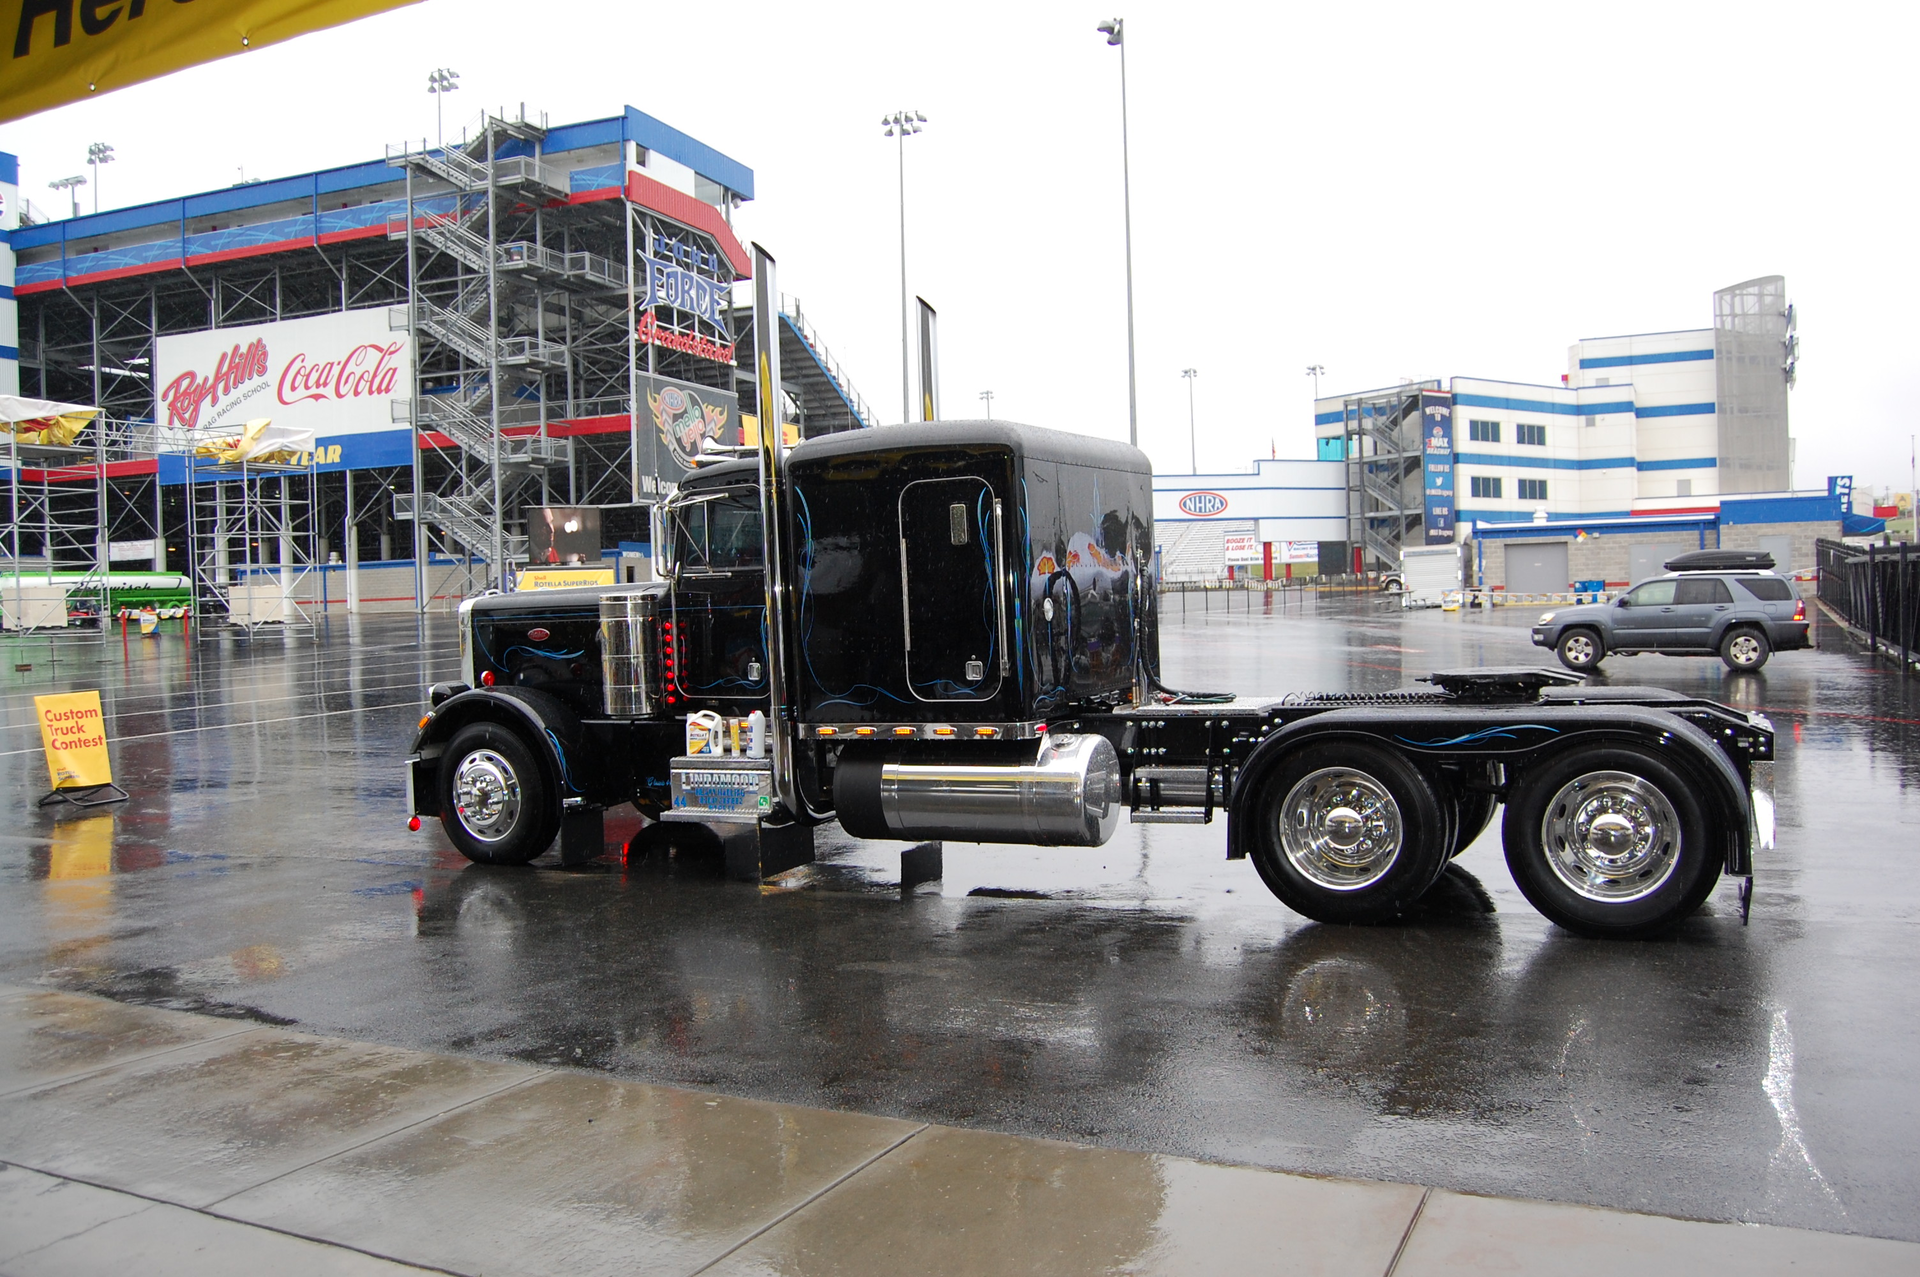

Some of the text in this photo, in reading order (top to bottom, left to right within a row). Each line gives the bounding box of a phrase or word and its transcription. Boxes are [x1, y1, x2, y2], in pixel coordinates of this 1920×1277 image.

[637, 249, 732, 341] FORCE
[637, 311, 736, 363] Grandstand
[216, 397, 243, 420] RACING
[242, 380, 271, 401] SCHOOL
[1186, 496, 1222, 513] NHRA
[44, 708, 99, 723] Custom
[47, 721, 86, 737] Truck
[51, 735, 104, 750] Contest
[682, 773, 759, 791] LINDAMOOD
[674, 796, 687, 807] 44
